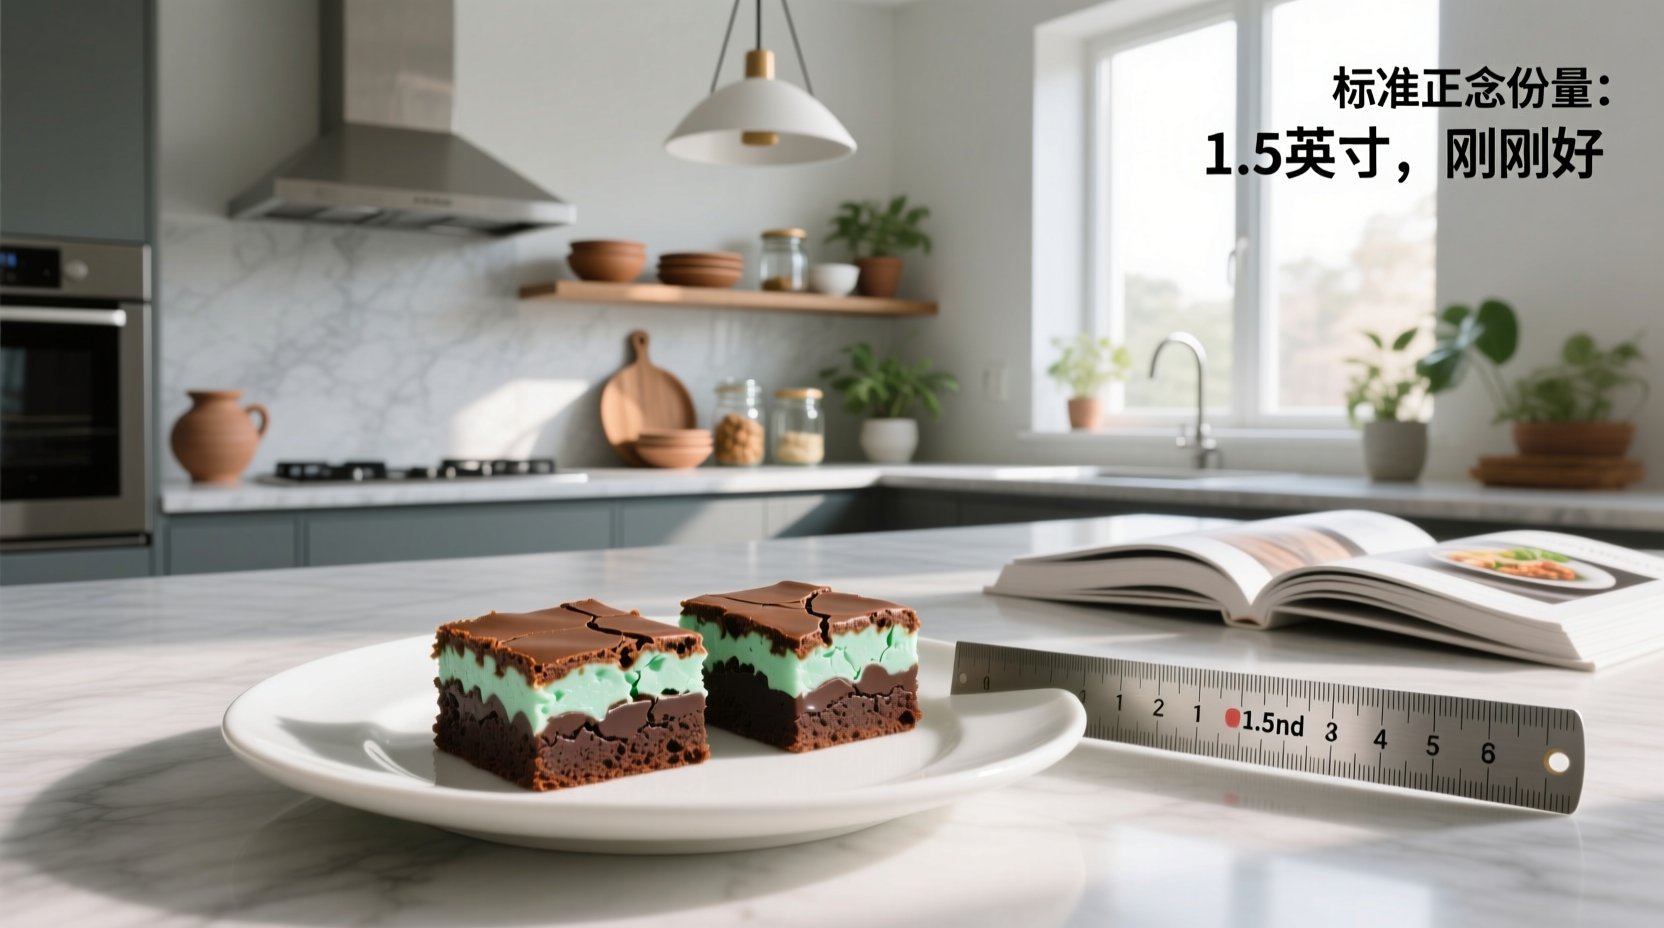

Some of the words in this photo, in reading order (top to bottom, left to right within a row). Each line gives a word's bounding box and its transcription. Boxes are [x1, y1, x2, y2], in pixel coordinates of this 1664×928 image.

[1115, 694, 1123, 712] 1
[1152, 698, 1165, 718] 2
[1193, 704, 1201, 723] 1
[1242, 710, 1304, 737] 1.5nd
[1373, 729, 1388, 750] 4
[1426, 735, 1440, 756] 5
[1481, 742, 1496, 765] 6
